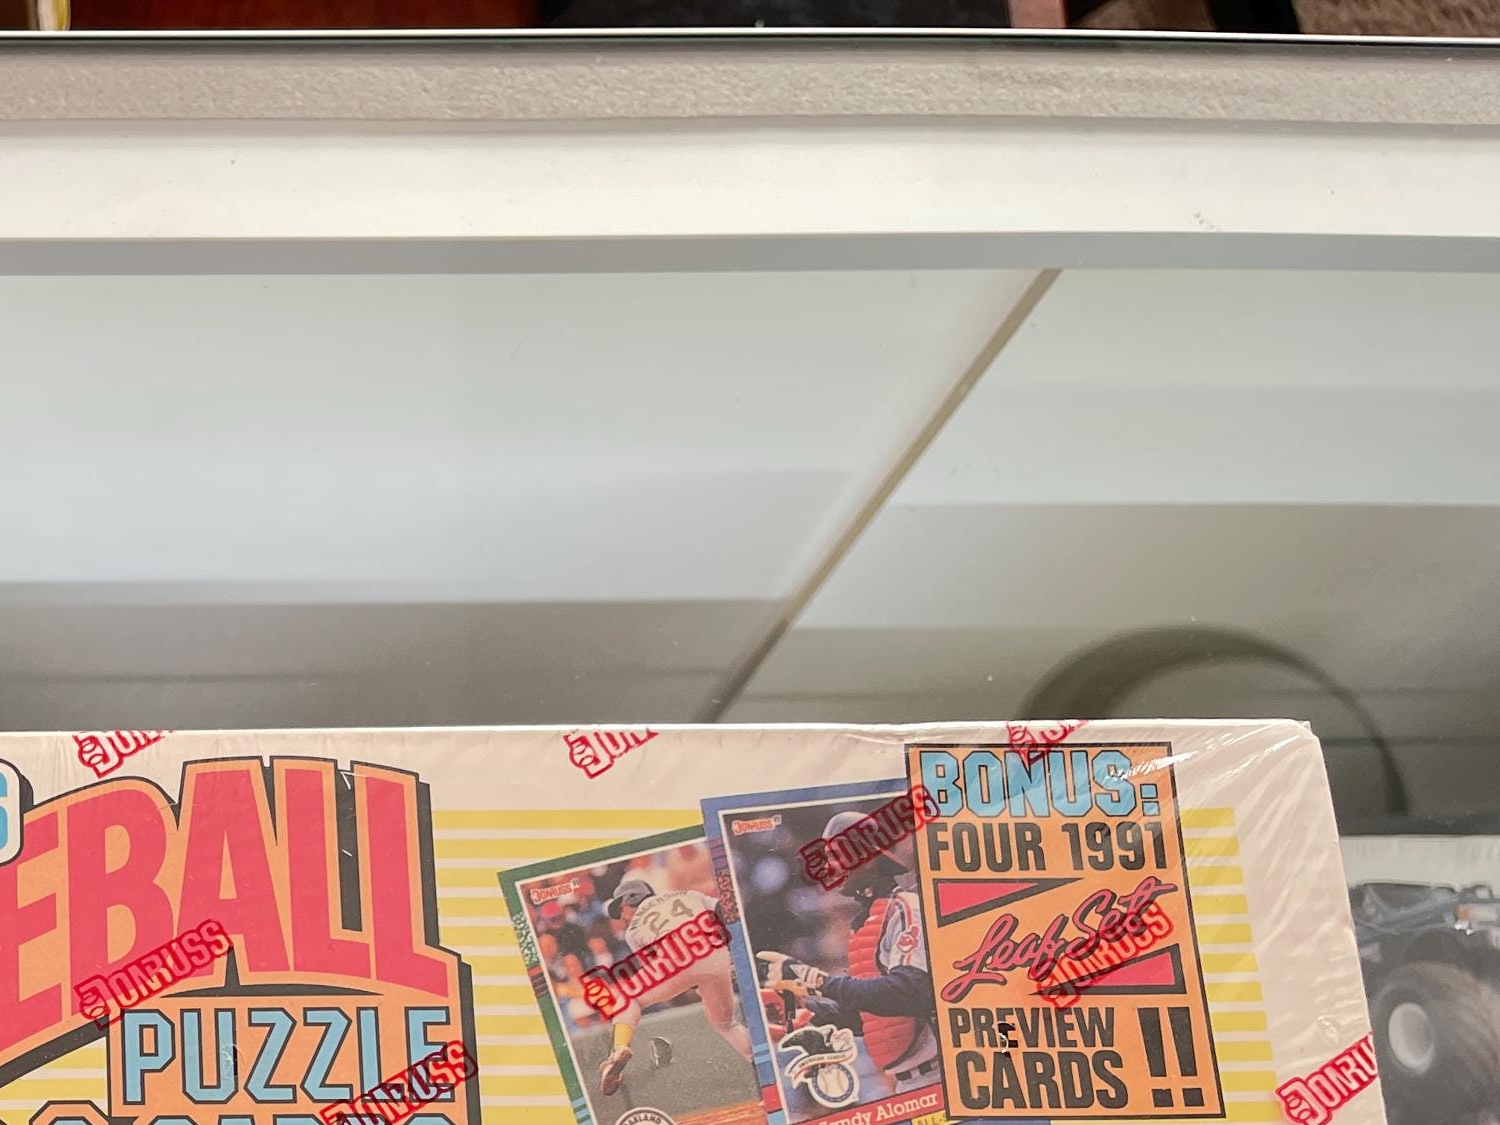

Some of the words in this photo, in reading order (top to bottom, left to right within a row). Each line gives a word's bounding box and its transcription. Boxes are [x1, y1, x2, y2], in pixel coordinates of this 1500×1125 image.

[919, 749, 1161, 818] BONUS:
[800, 785, 941, 891] DONRUSS
[926, 820, 1045, 872] FOUR
[1062, 820, 1167, 871] 1991
[74, 919, 234, 1029] DONRUSS
[580, 909, 732, 1020] DONRUSS
[941, 910, 1070, 1003] Leaf
[1067, 876, 1178, 958] Set
[122, 1007, 455, 1105] PUZZLE
[948, 1006, 1115, 1049] PREVIEW
[876, 1093, 938, 1122] Alomar
[955, 1049, 1128, 1111] CARDS
